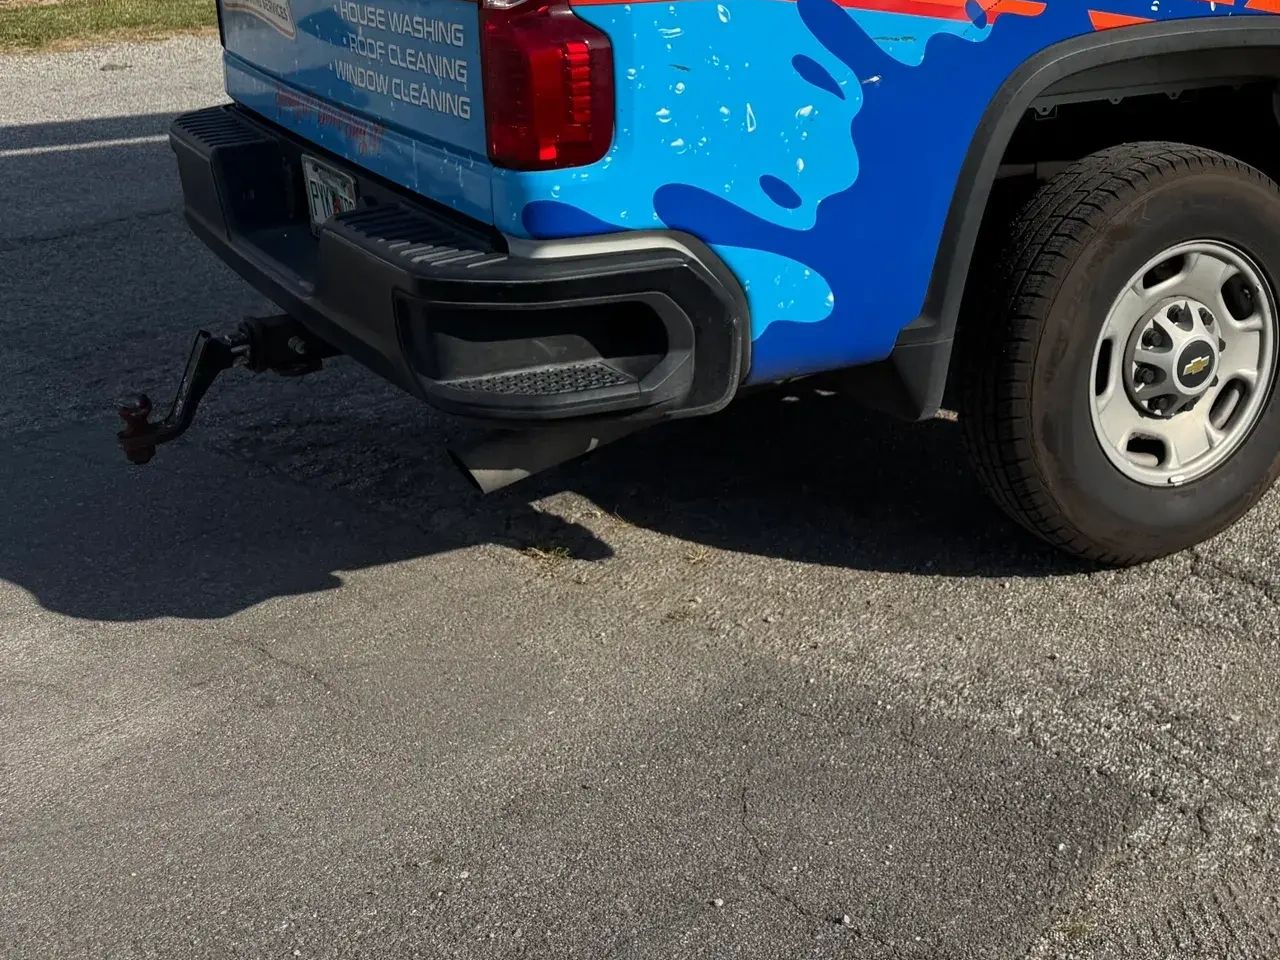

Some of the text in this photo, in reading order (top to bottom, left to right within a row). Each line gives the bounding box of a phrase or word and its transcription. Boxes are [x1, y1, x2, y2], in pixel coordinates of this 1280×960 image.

[339, 0, 464, 46] HOUSE WASHING
[349, 33, 467, 83] ROOF CLEANING
[335, 60, 470, 119] WINDOW CLEANING
